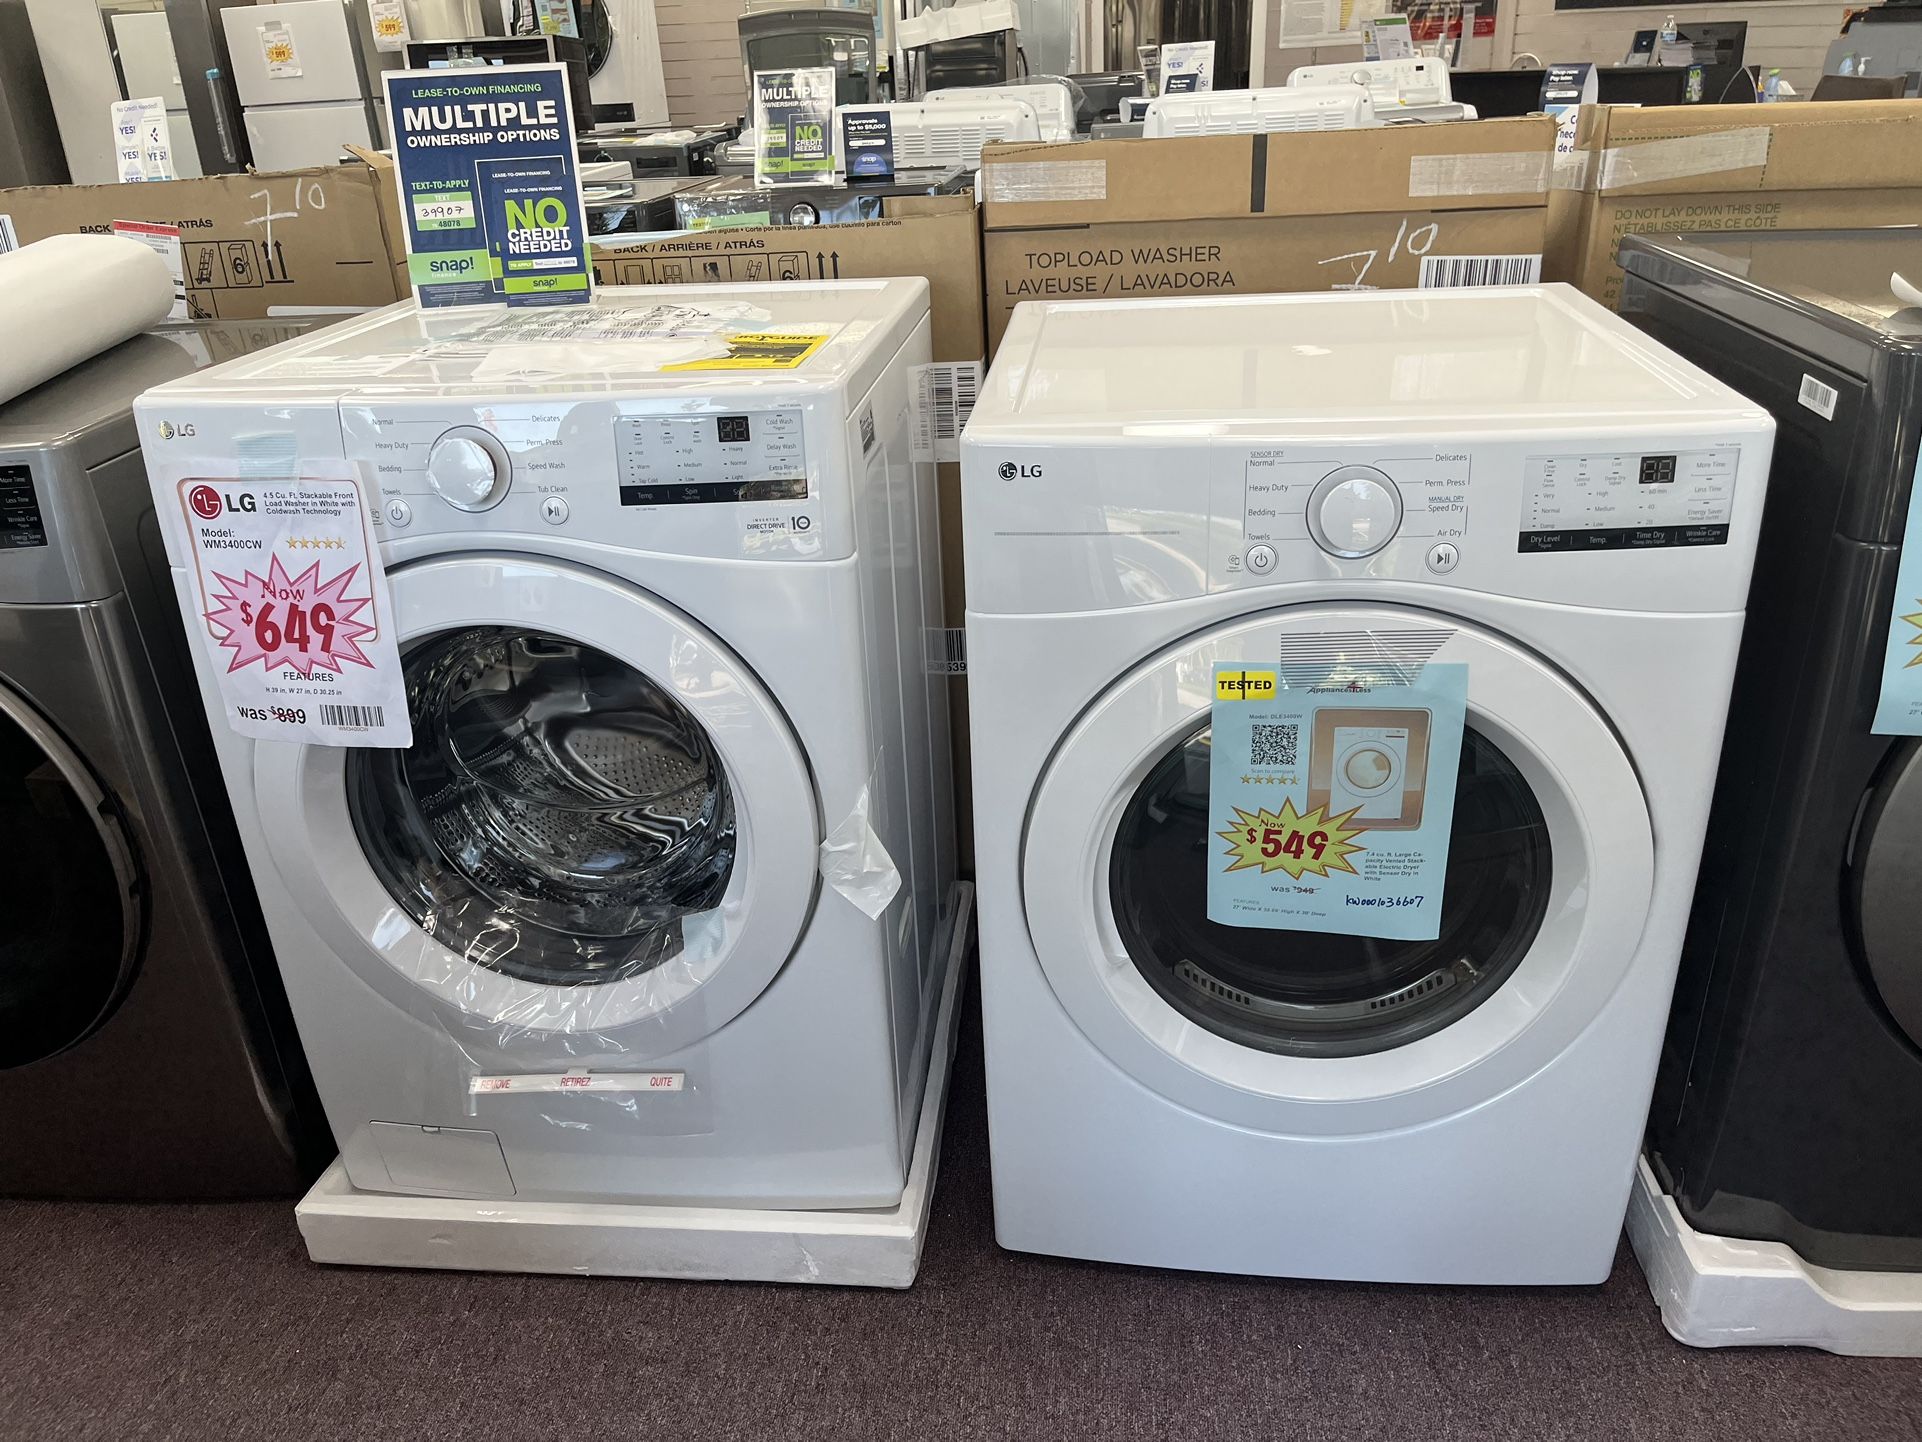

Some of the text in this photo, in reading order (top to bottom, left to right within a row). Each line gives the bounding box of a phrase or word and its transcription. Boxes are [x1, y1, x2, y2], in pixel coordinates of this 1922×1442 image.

[412, 83, 542, 98] LEASE-TO-OWN FINANCING
[761, 85, 830, 100] MULTIPLE
[403, 100, 559, 132] MULTIPLE
[120, 126, 136, 135] YES!
[795, 123, 822, 140] NO
[407, 128, 560, 148] OWNERSHIP OPTIONS
[795, 138, 823, 146] CREDIT
[122, 151, 139, 160] YES!
[411, 179, 470, 191] TEXT-TO-APPLY
[434, 194, 451, 202] TEXT
[421, 206, 464, 218] 39907
[504, 196, 568, 230] NO
[1615, 203, 1782, 221] DO NOT LAY DOWN THIS SIDE
[80, 223, 111, 234] BACK
[177, 217, 214, 229] ATRÁS
[438, 220, 461, 228] 48078
[1699, 219, 1722, 230] PAS
[1725, 217, 1741, 228] CE
[1744, 214, 1778, 228] CÔTÉ
[507, 226, 570, 242] CREDIT
[508, 239, 573, 254] NEEDED
[613, 238, 765, 254] BACK ARRIÈRE ATRÁS
[1025, 245, 1222, 270] TOPLOAD WASHER
[430, 256, 475, 274] snap!
[533, 277, 558, 288] snap!
[1005, 270, 1236, 296] LAVEUSE LAVADORA
[531, 415, 561, 423] Delicates
[177, 424, 196, 437] LG
[375, 441, 409, 450] Heavy Duty
[766, 443, 781, 451] Delay
[1435, 453, 1468, 462] Delicates
[527, 462, 566, 471] Speed Wash
[1249, 459, 1275, 467] Normal
[378, 465, 402, 474] Bedding
[1021, 464, 1042, 478] LG
[1249, 483, 1289, 492] Heavy Duty
[1425, 478, 1466, 487] Perm. Press
[382, 488, 401, 496] Towels
[550, 485, 568, 493] Clean
[263, 491, 275, 499] 4.5
[289, 491, 298, 499] Ft.
[224, 493, 257, 513] LG
[1428, 503, 1464, 513] Speed Dry
[302, 508, 342, 516] Technology
[1248, 508, 1276, 517] Bedding
[791, 515, 811, 531] 10
[201, 528, 235, 538] Model:
[1248, 533, 1270, 541] Towels
[1437, 528, 1462, 538] Air Dry
[1636, 531, 1665, 539] Time Dry
[1530, 535, 1542, 543] Dry
[1589, 536, 1607, 544] Temp.
[203, 540, 262, 550] WM3400CW
[261, 579, 305, 601] Now
[240, 600, 336, 653] $649
[283, 671, 334, 682] FEATURES
[1218, 680, 1272, 690] TESTED
[269, 705, 306, 724] $899
[1259, 817, 1286, 829] Now
[1246, 827, 1329, 861] $549
[480, 1079, 511, 1089] REMOVE
[560, 1077, 591, 1087] RETIREZ
[650, 1077, 673, 1087] QUITE
